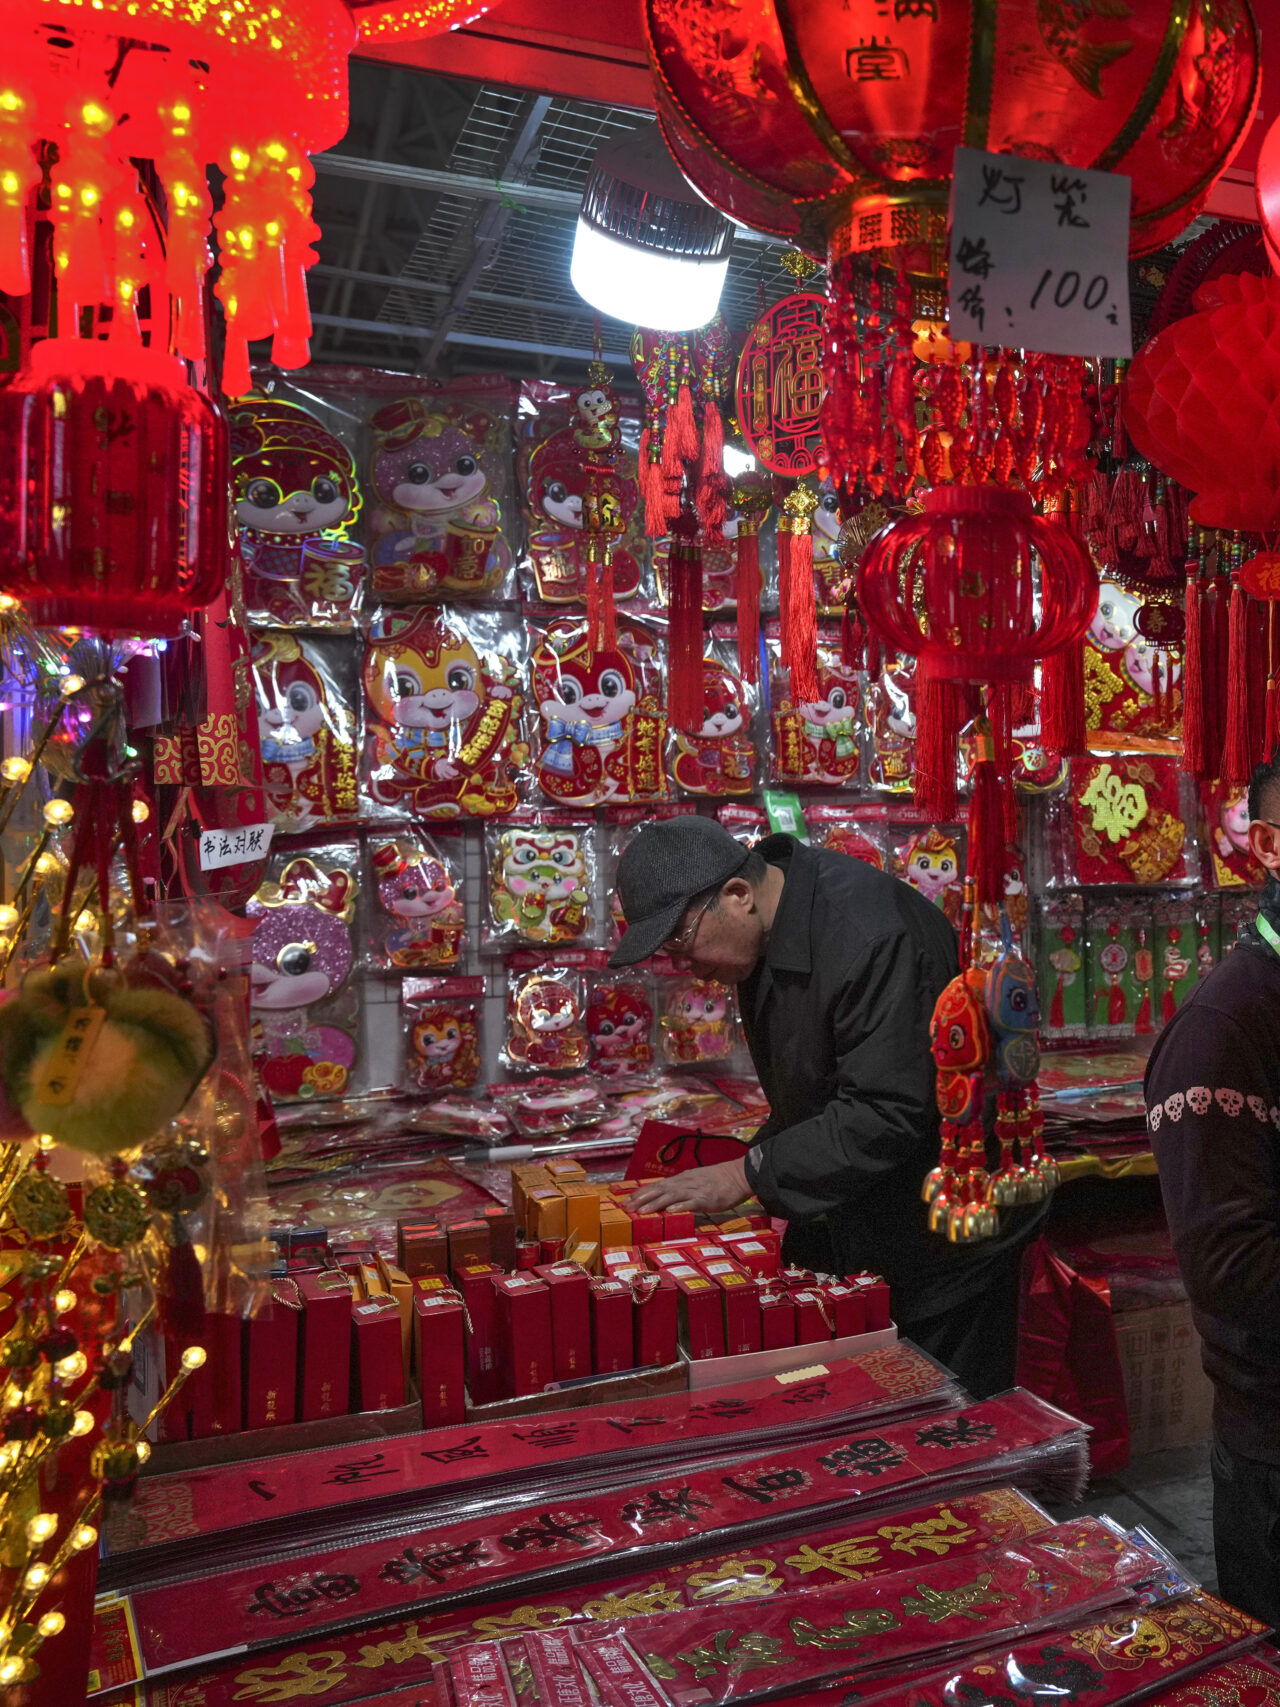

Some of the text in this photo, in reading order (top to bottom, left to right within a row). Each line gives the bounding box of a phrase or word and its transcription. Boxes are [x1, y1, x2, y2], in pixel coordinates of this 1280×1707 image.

[773, 334, 824, 420] 福
[304, 562, 355, 601] 福
[1146, 610, 1168, 634] 春
[634, 717, 657, 790] 蛇年好運
[203, 829, 266, 864] 书法对联
[643, 1572, 1016, 1682] 添富貴
